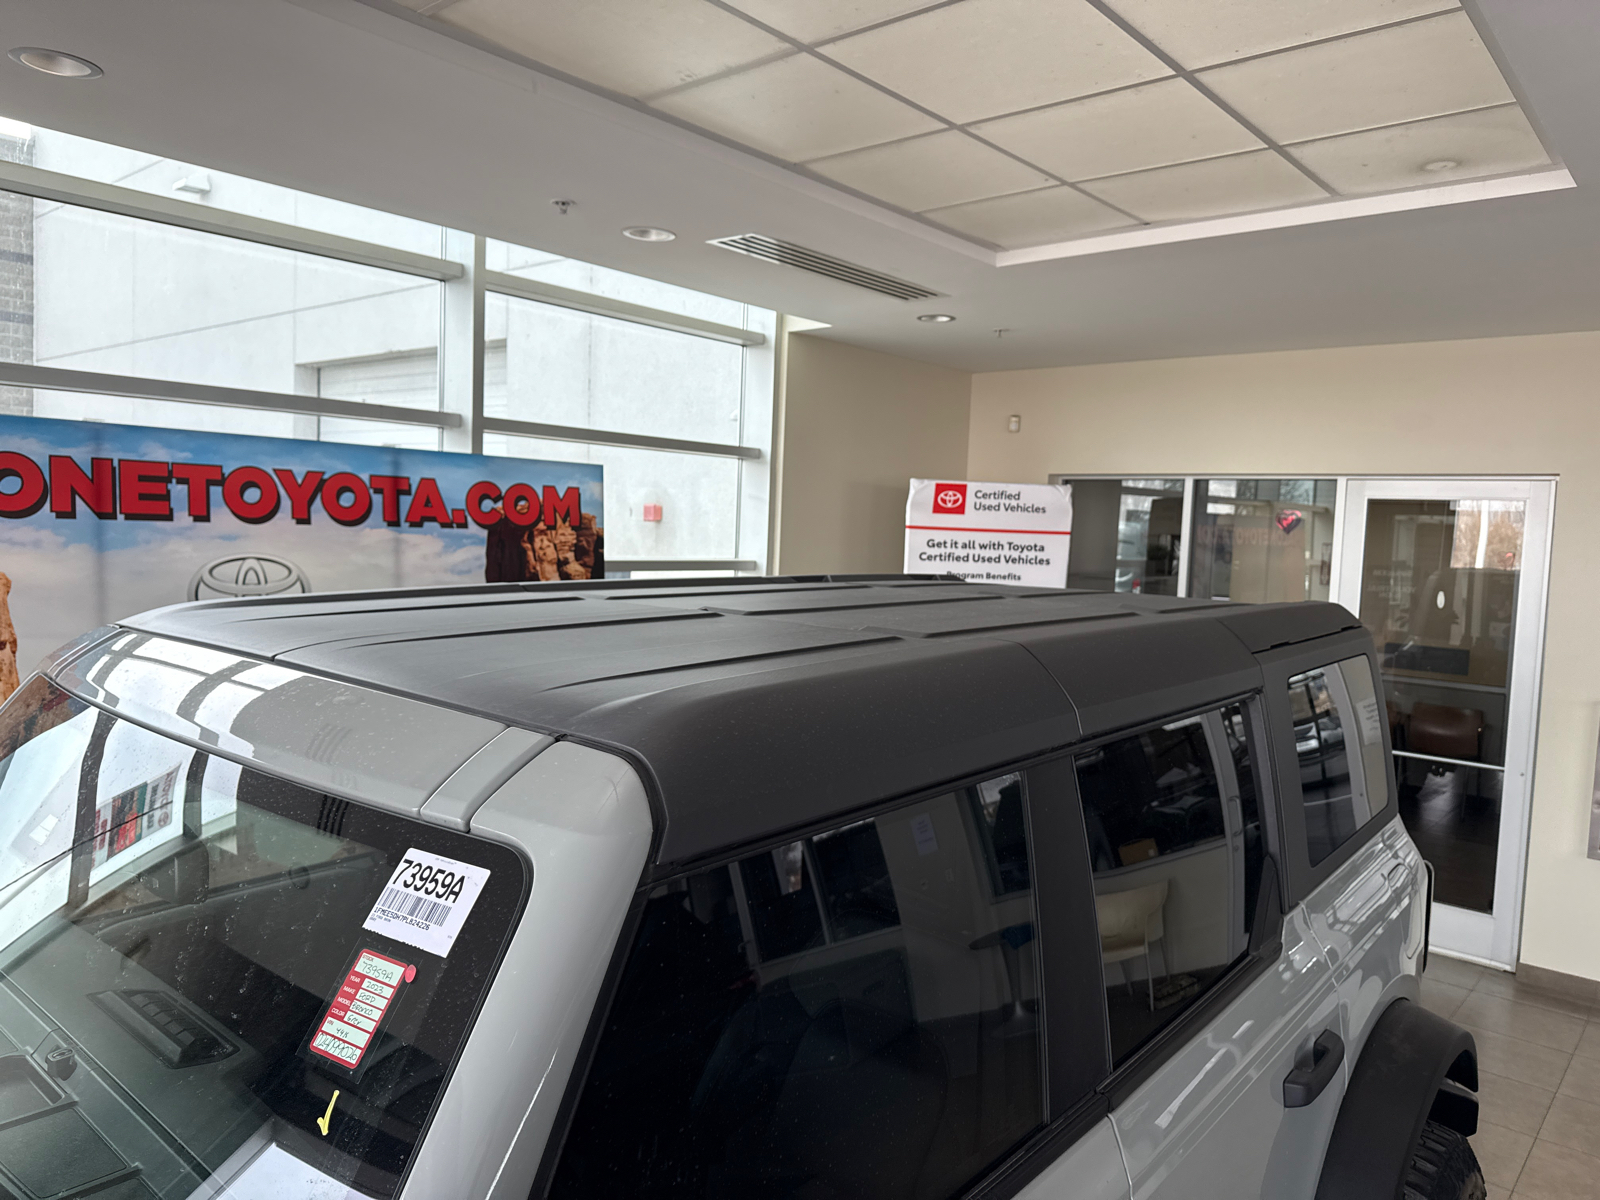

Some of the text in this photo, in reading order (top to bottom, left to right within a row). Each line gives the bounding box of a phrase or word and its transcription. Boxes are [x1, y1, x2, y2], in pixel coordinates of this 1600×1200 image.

[974, 489, 1021, 501] Certified
[974, 502, 1047, 514] Used Vehicles
[926, 539, 1045, 554] Get it all with Toyota
[919, 552, 1051, 566] Certified Used Vehicles
[985, 572, 1022, 581] Benefits
[392, 858, 466, 904] 73959A
[361, 954, 375, 962] STOCK
[362, 960, 394, 982] 73959A
[350, 975, 361, 983] YEAR
[343, 985, 356, 995] MAKE
[366, 980, 384, 994] 2023
[337, 997, 351, 1007] MODEL
[358, 991, 376, 1004] FORD
[331, 1007, 346, 1017] COLOR
